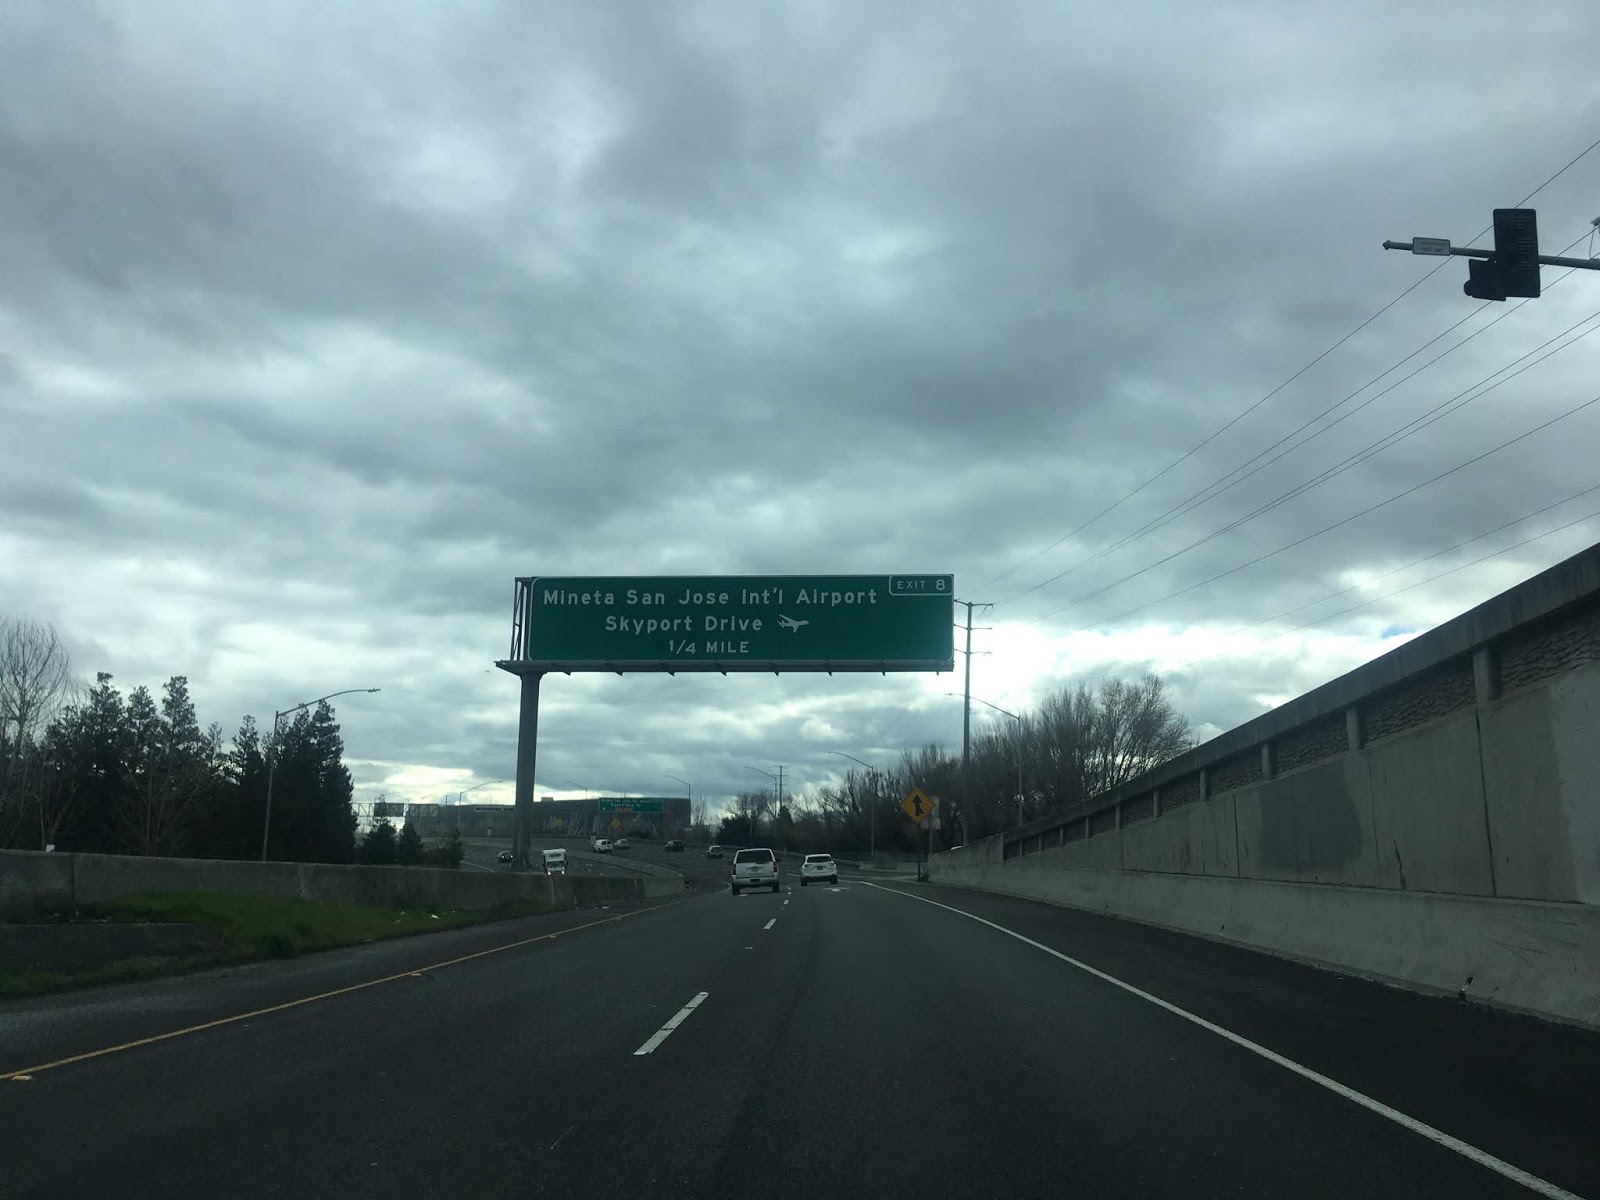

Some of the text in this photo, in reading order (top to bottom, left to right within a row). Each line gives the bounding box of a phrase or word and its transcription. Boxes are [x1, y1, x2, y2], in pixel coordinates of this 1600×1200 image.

[897, 579, 946, 591] EXIT 8
[543, 587, 878, 607] Mineta San Jose Int'l Airport
[605, 615, 763, 636] Skyport Drive
[668, 639, 750, 655] 1/4 MILE
